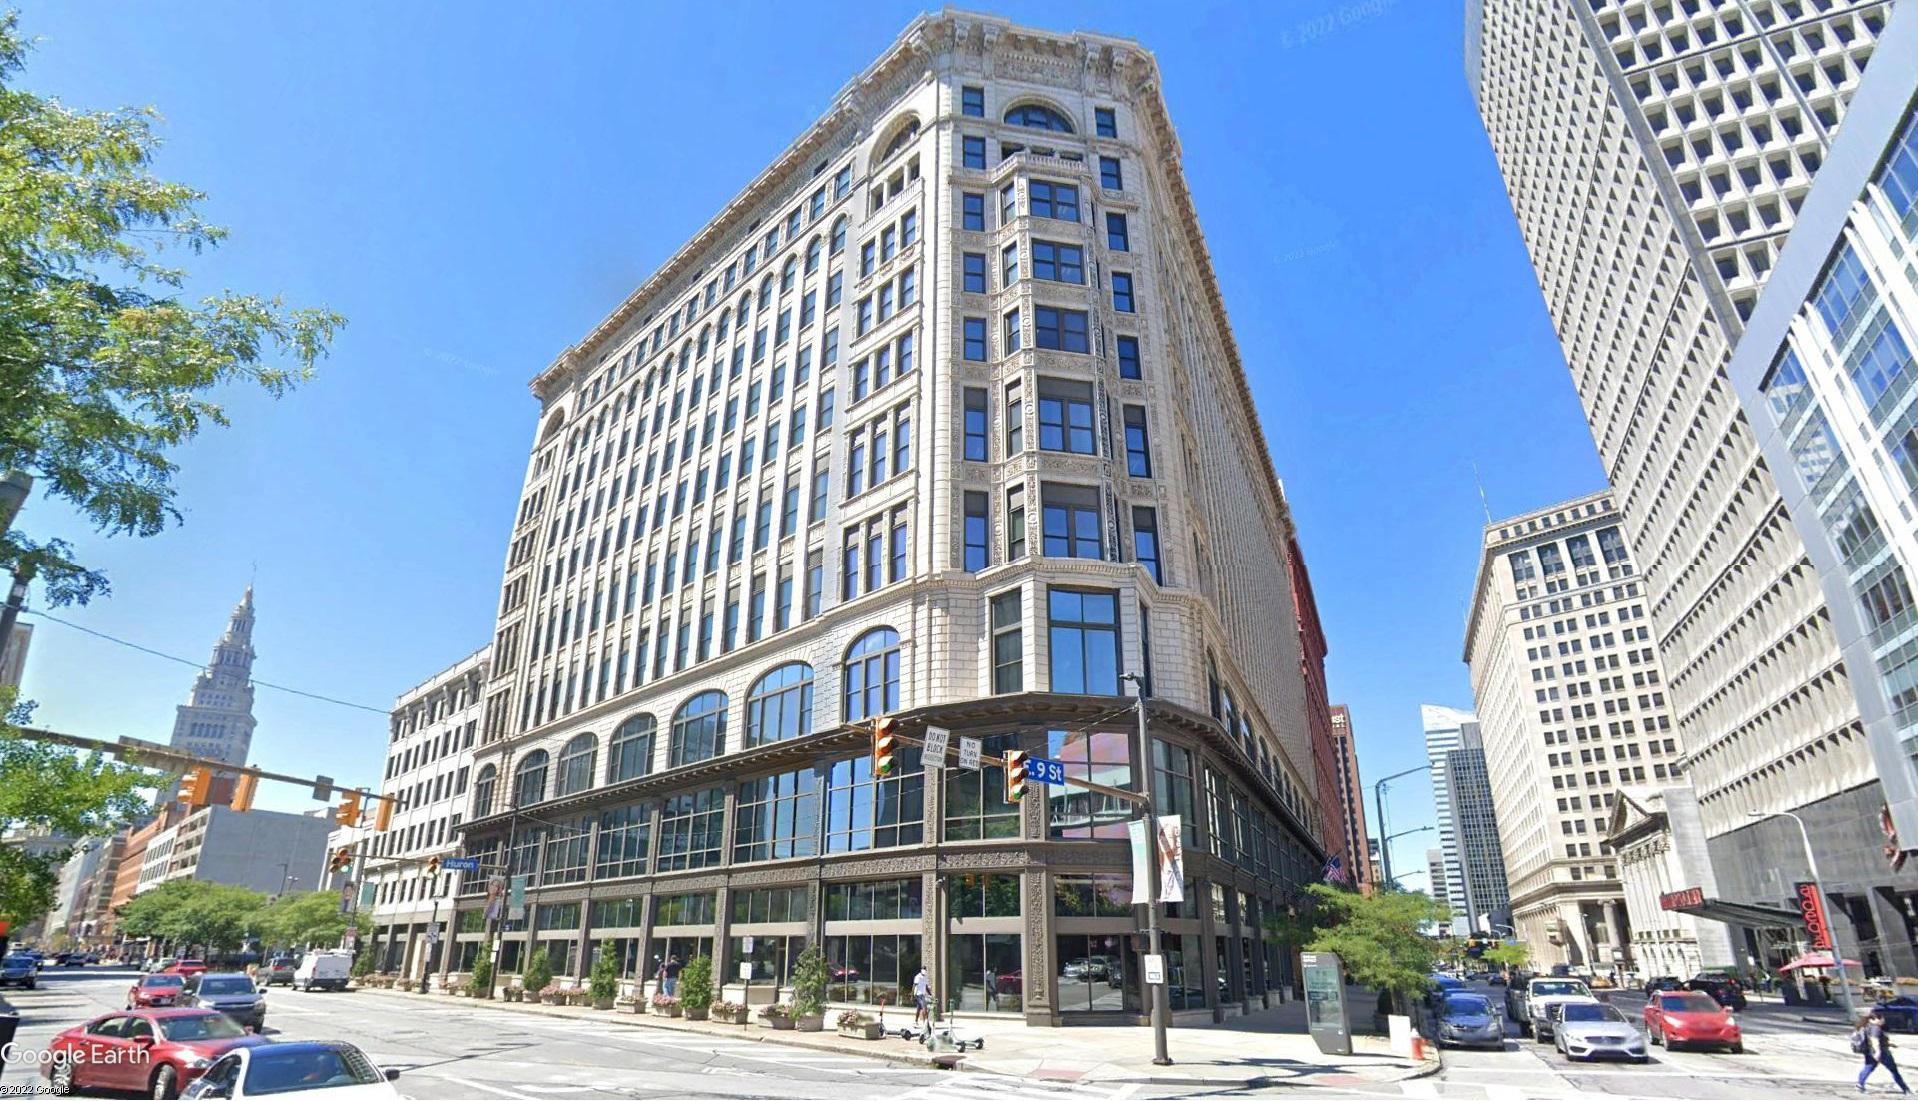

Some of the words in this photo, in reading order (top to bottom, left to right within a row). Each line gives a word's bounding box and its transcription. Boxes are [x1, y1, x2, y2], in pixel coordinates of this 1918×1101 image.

[928, 731, 936, 741] DO
[936, 733, 946, 744] NOT
[926, 743, 943, 754] BLOCK
[966, 741, 976, 749] NO
[964, 749, 978, 758] TURN
[1037, 761, 1046, 778] 9
[1049, 763, 1062, 782] St
[446, 859, 474, 869] Huron
